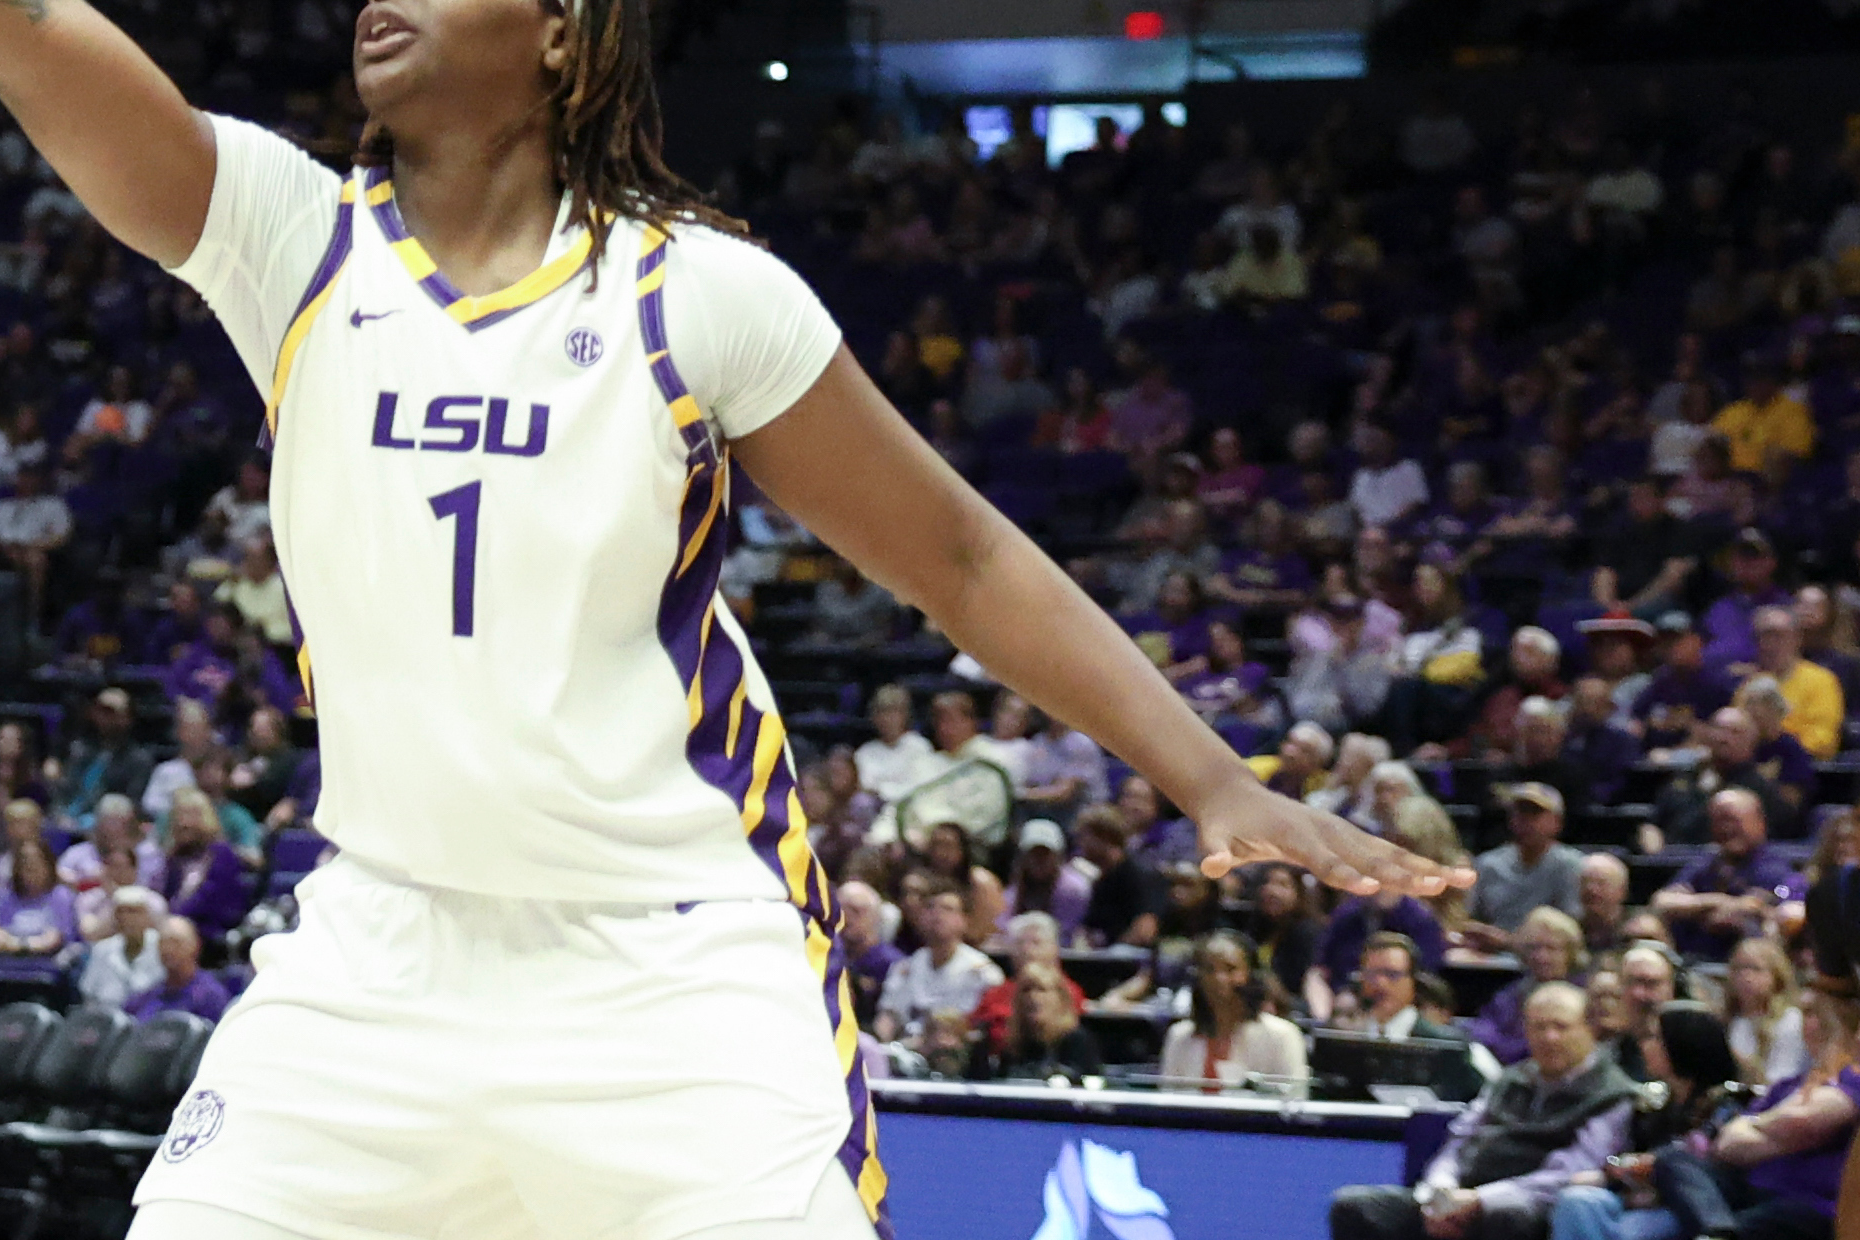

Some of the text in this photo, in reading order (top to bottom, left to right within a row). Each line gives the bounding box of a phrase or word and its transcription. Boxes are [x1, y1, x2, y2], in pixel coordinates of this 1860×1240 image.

[567, 328, 601, 364] SEC
[371, 391, 551, 458] LSU
[427, 479, 482, 638] 1
